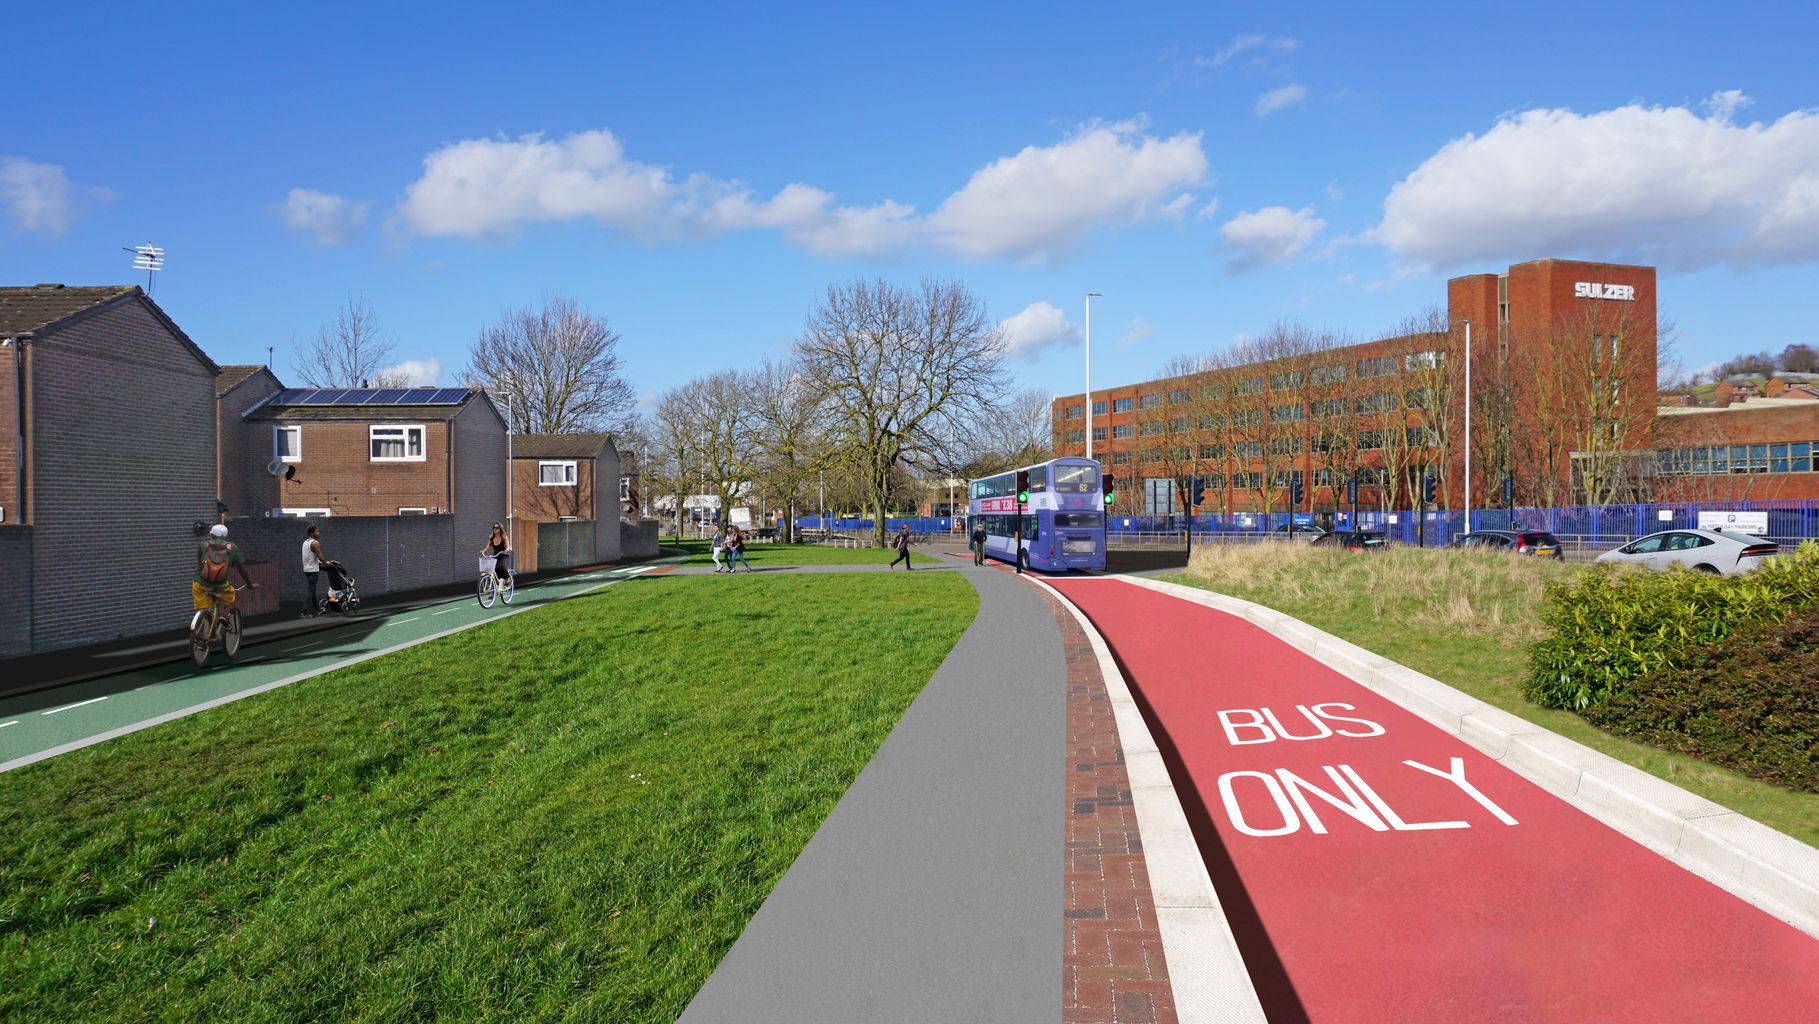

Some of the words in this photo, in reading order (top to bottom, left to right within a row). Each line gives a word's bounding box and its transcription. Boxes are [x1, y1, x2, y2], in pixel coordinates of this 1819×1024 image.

[1575, 281, 1635, 301] SULZER
[1079, 483, 1088, 492] 52
[1216, 703, 1386, 746] BUS
[1217, 757, 1520, 837] ONLY
